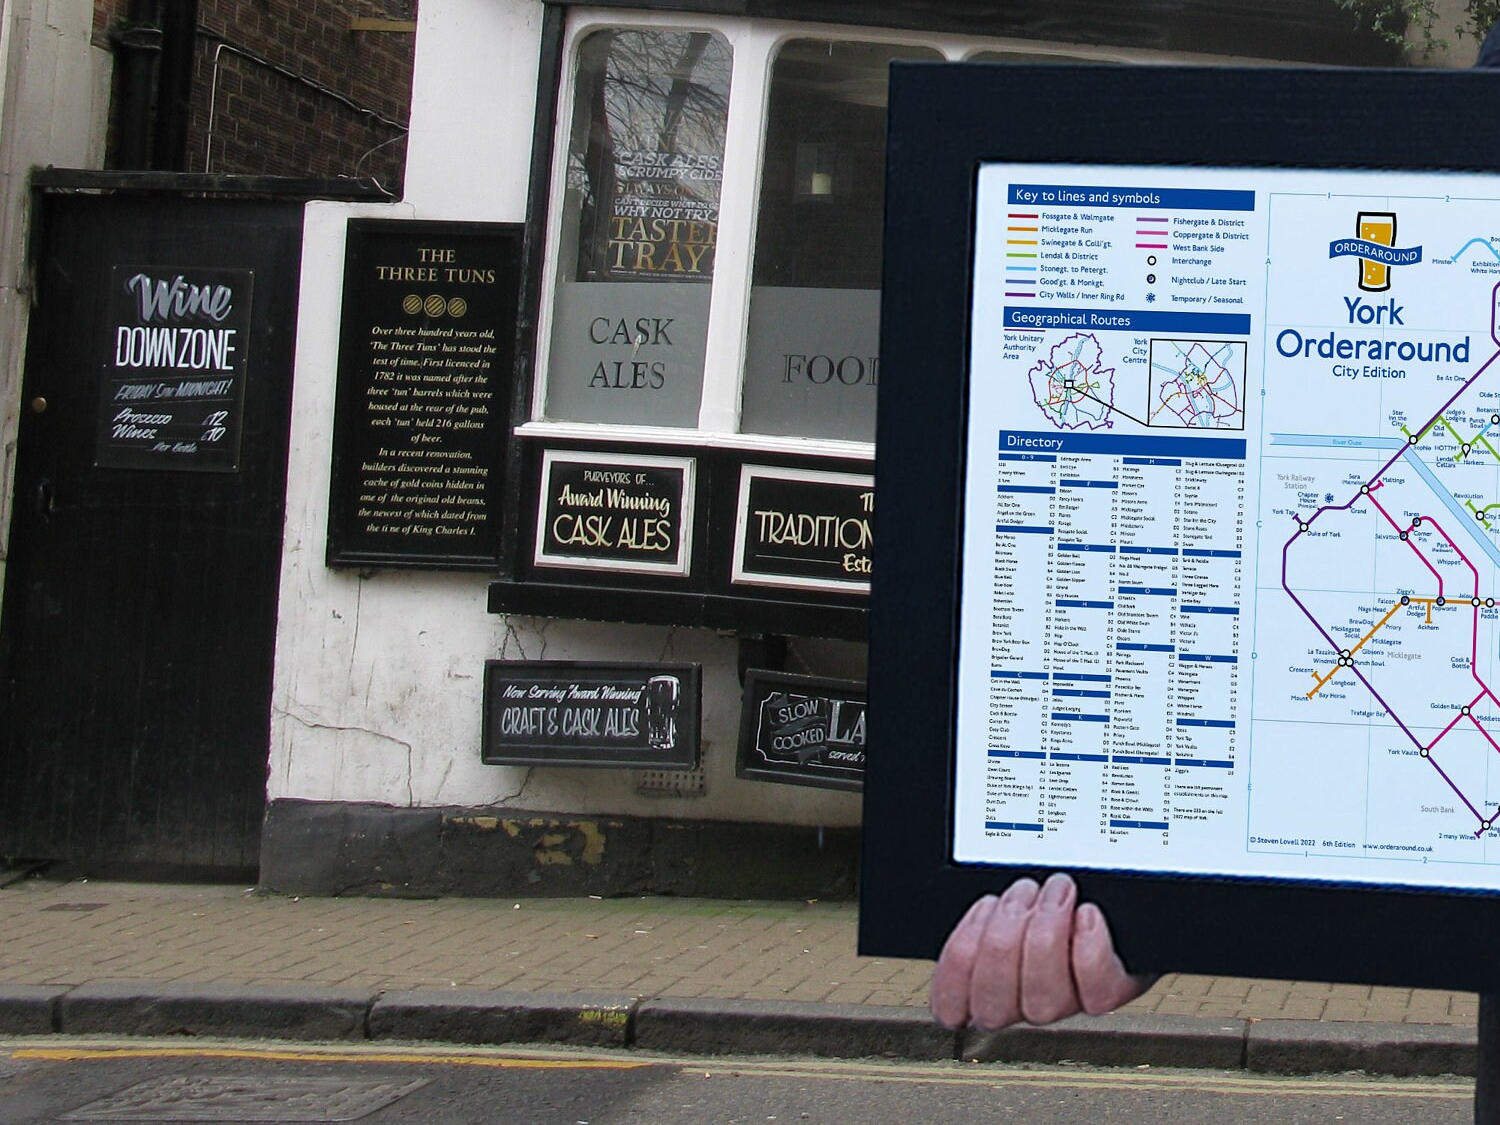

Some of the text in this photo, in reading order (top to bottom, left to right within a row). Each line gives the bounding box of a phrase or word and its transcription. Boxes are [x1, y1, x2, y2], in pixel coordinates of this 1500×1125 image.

[620, 152, 721, 169] CASK ALES
[618, 166, 689, 179] SCRUMPY
[1015, 189, 1160, 206] Key to lines and symbols
[614, 206, 713, 220] WHY NOT TRY
[1042, 212, 1114, 223] Fossgate & Walmgate
[1173, 218, 1209, 227] Fishergate
[1218, 219, 1244, 227] District
[1041, 226, 1078, 235] Micklegate
[1173, 231, 1249, 241] Coppergate & District
[1041, 239, 1076, 248] Swinegate
[1173, 244, 1190, 252] West
[1210, 245, 1225, 253] Side
[418, 248, 456, 263] THE
[1040, 252, 1063, 260] Lendal
[1071, 253, 1098, 261] District
[1334, 242, 1418, 262] ORDERAROUND
[1040, 265, 1069, 274] Stonegt.
[1080, 266, 1108, 275] Petergt.
[1172, 258, 1212, 267] Interchange
[376, 266, 496, 283] THREE TUNS
[1171, 276, 1205, 285] Nightclub
[1212, 277, 1227, 285] Late
[1229, 278, 1246, 286] Start
[126, 273, 233, 321] Wine
[1039, 291, 1054, 300] City
[1056, 291, 1075, 299] Walls
[1081, 292, 1098, 300] Inner
[1100, 292, 1115, 302] Ring
[1117, 293, 1125, 301] Rd
[1344, 296, 1404, 325] York
[1012, 311, 1131, 326] Geographical Routes
[372, 326, 495, 339] Over three hundred years old,
[589, 316, 675, 347] CASK
[390, 341, 414, 351] Three
[442, 343, 457, 352] has
[459, 344, 482, 353] stood
[483, 344, 497, 354] the
[1276, 329, 1470, 363] Orderaround
[372, 357, 490, 368] test of time. First licenced in
[374, 371, 395, 380] 1782
[396, 373, 403, 381] it
[423, 374, 451, 383] named
[452, 374, 473, 384] after
[474, 374, 488, 383] the
[588, 361, 666, 390] ALES
[1332, 365, 1406, 379] City Edition
[114, 384, 157, 400] FRIDAY
[113, 407, 228, 426] Prosecco £12
[112, 424, 226, 441] Wines £10
[153, 441, 171, 451] Per
[1007, 435, 1064, 450] Directory
[584, 470, 655, 486] PURVEYORS OF...
[558, 484, 670, 518] Award Winning
[553, 514, 671, 551] CASK ALES
[502, 685, 646, 704] Now Serving "Award Winning"
[778, 699, 819, 723] SLOW
[501, 707, 640, 737] CRAFT & CASK ALES
[774, 728, 824, 750] COOKED
[828, 750, 862, 761] served
[1335, 840, 1356, 848] Edition
[1362, 843, 1434, 852] www.orderaround.co.uk
